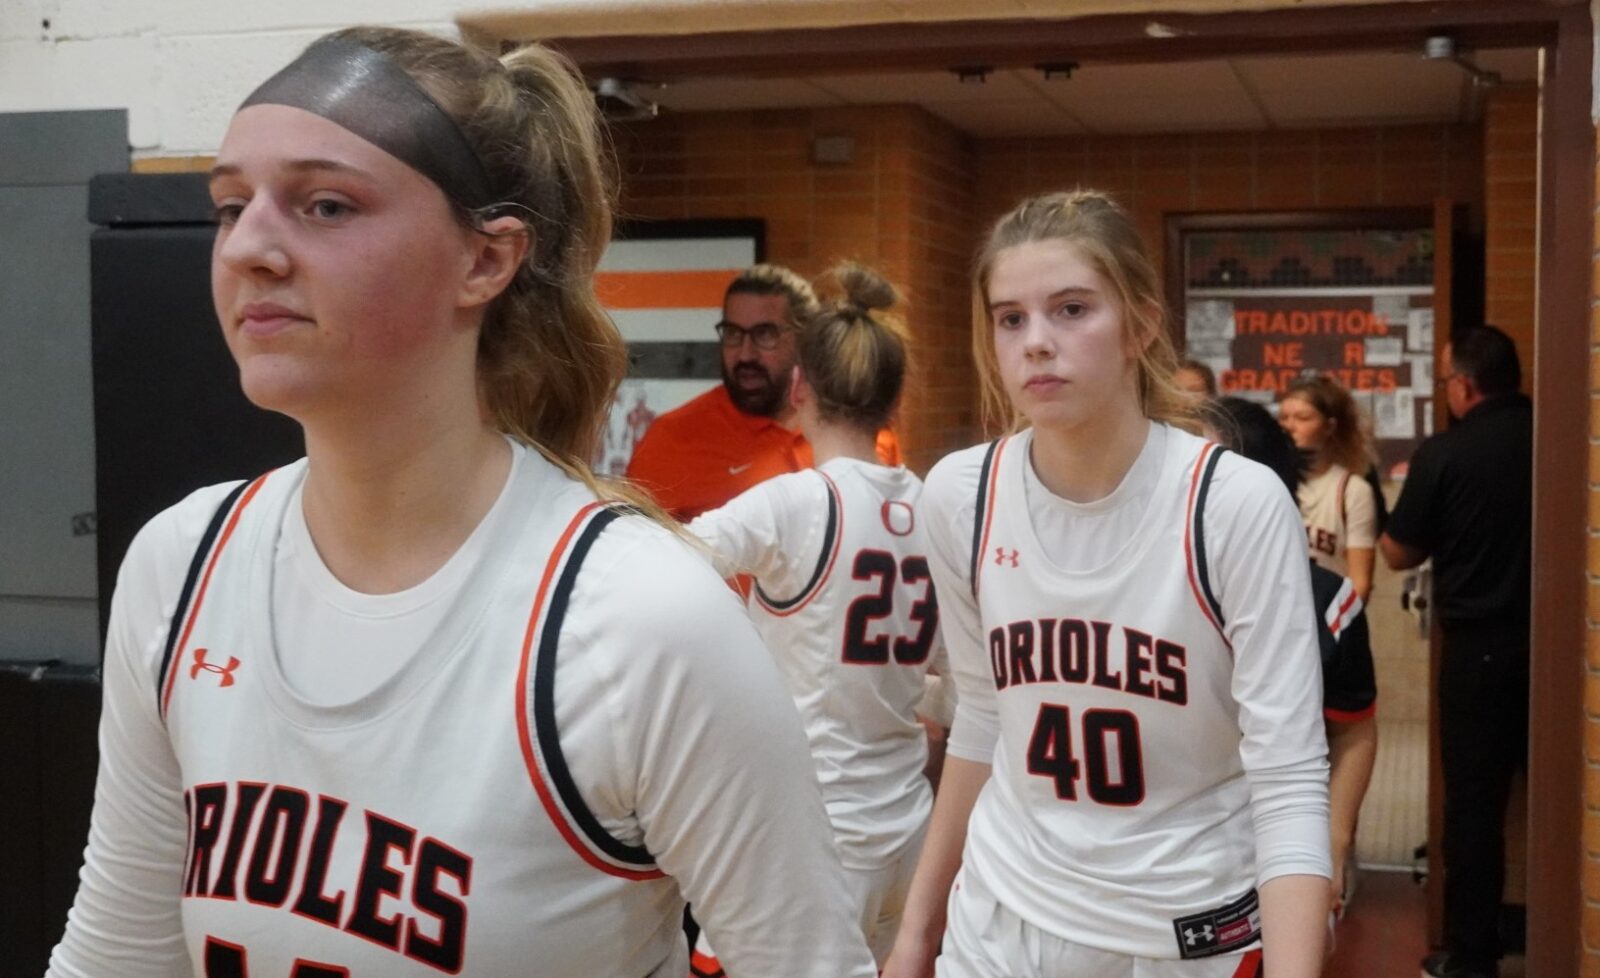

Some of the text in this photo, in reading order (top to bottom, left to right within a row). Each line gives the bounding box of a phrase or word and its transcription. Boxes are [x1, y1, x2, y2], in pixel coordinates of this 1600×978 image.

[1234, 310, 1388, 335] TRADITION
[841, 548, 939, 665] 23
[990, 618, 1188, 706] ORIOLES
[1027, 702, 1146, 807] 40
[183, 781, 474, 976] RIOLES
